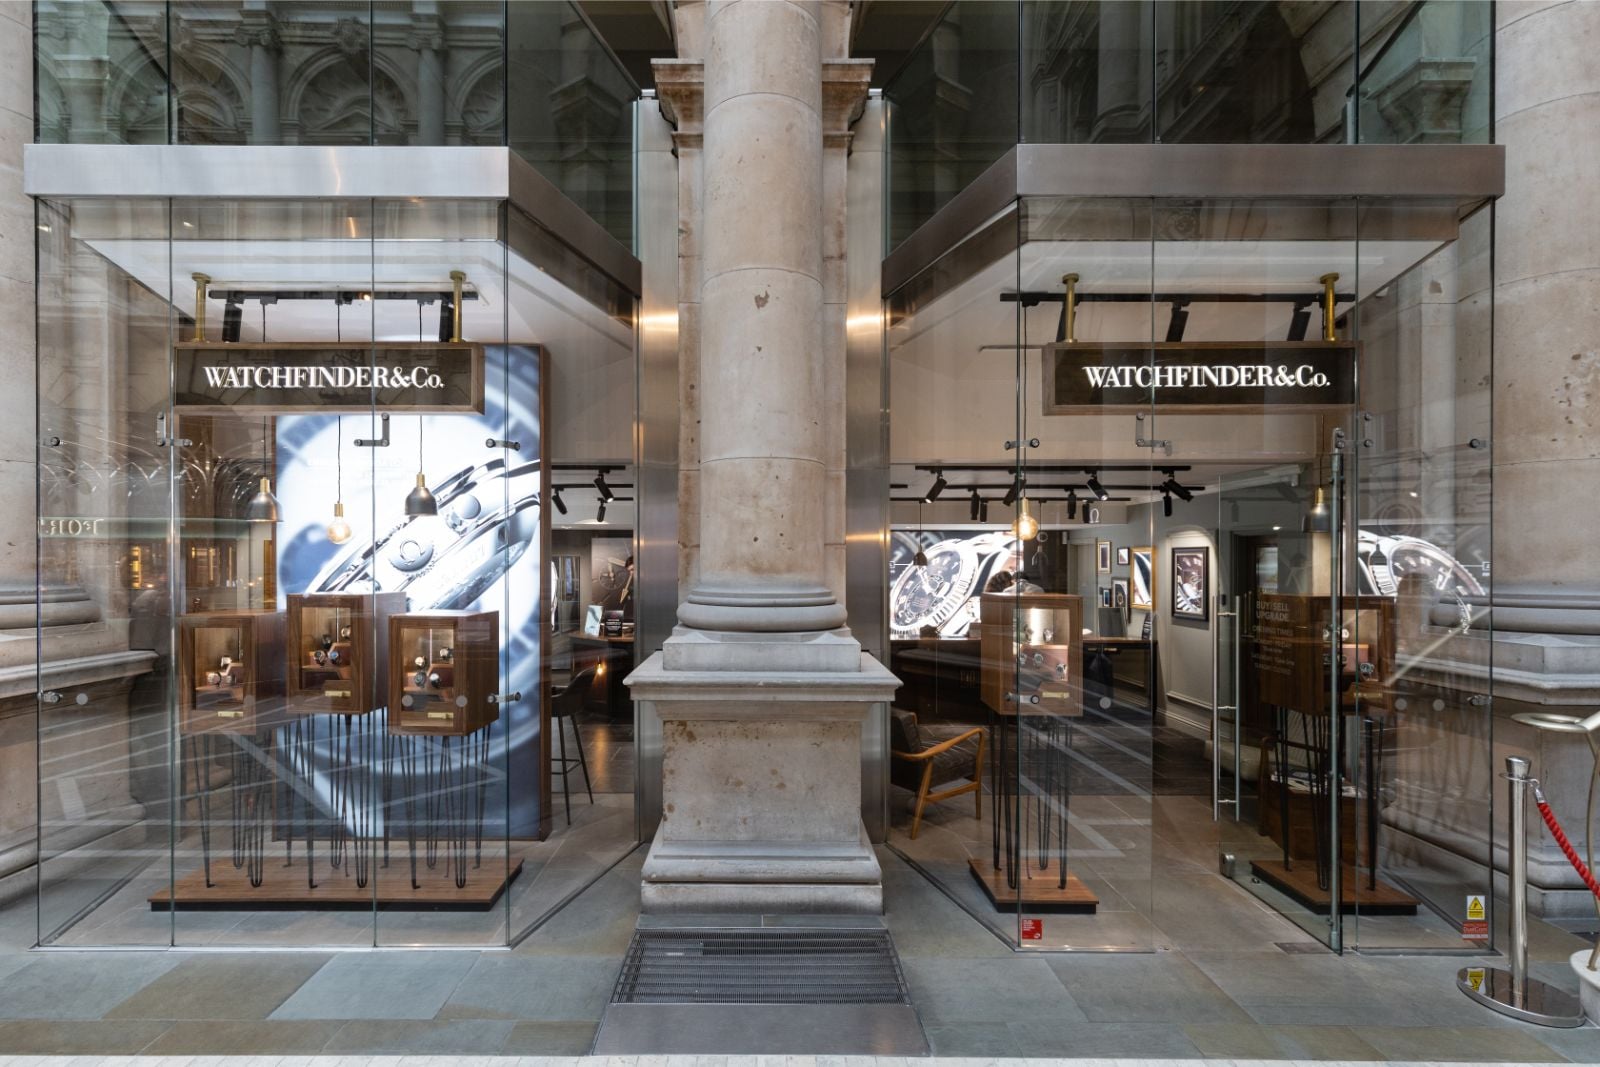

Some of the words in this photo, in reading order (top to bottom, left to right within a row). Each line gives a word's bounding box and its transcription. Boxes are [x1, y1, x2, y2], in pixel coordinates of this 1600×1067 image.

[202, 366, 445, 389] WATCHFINDER&Co.
[1082, 365, 1331, 388] WATCHFINDER&Co.
[1256, 611, 1289, 622] UPGRADE
